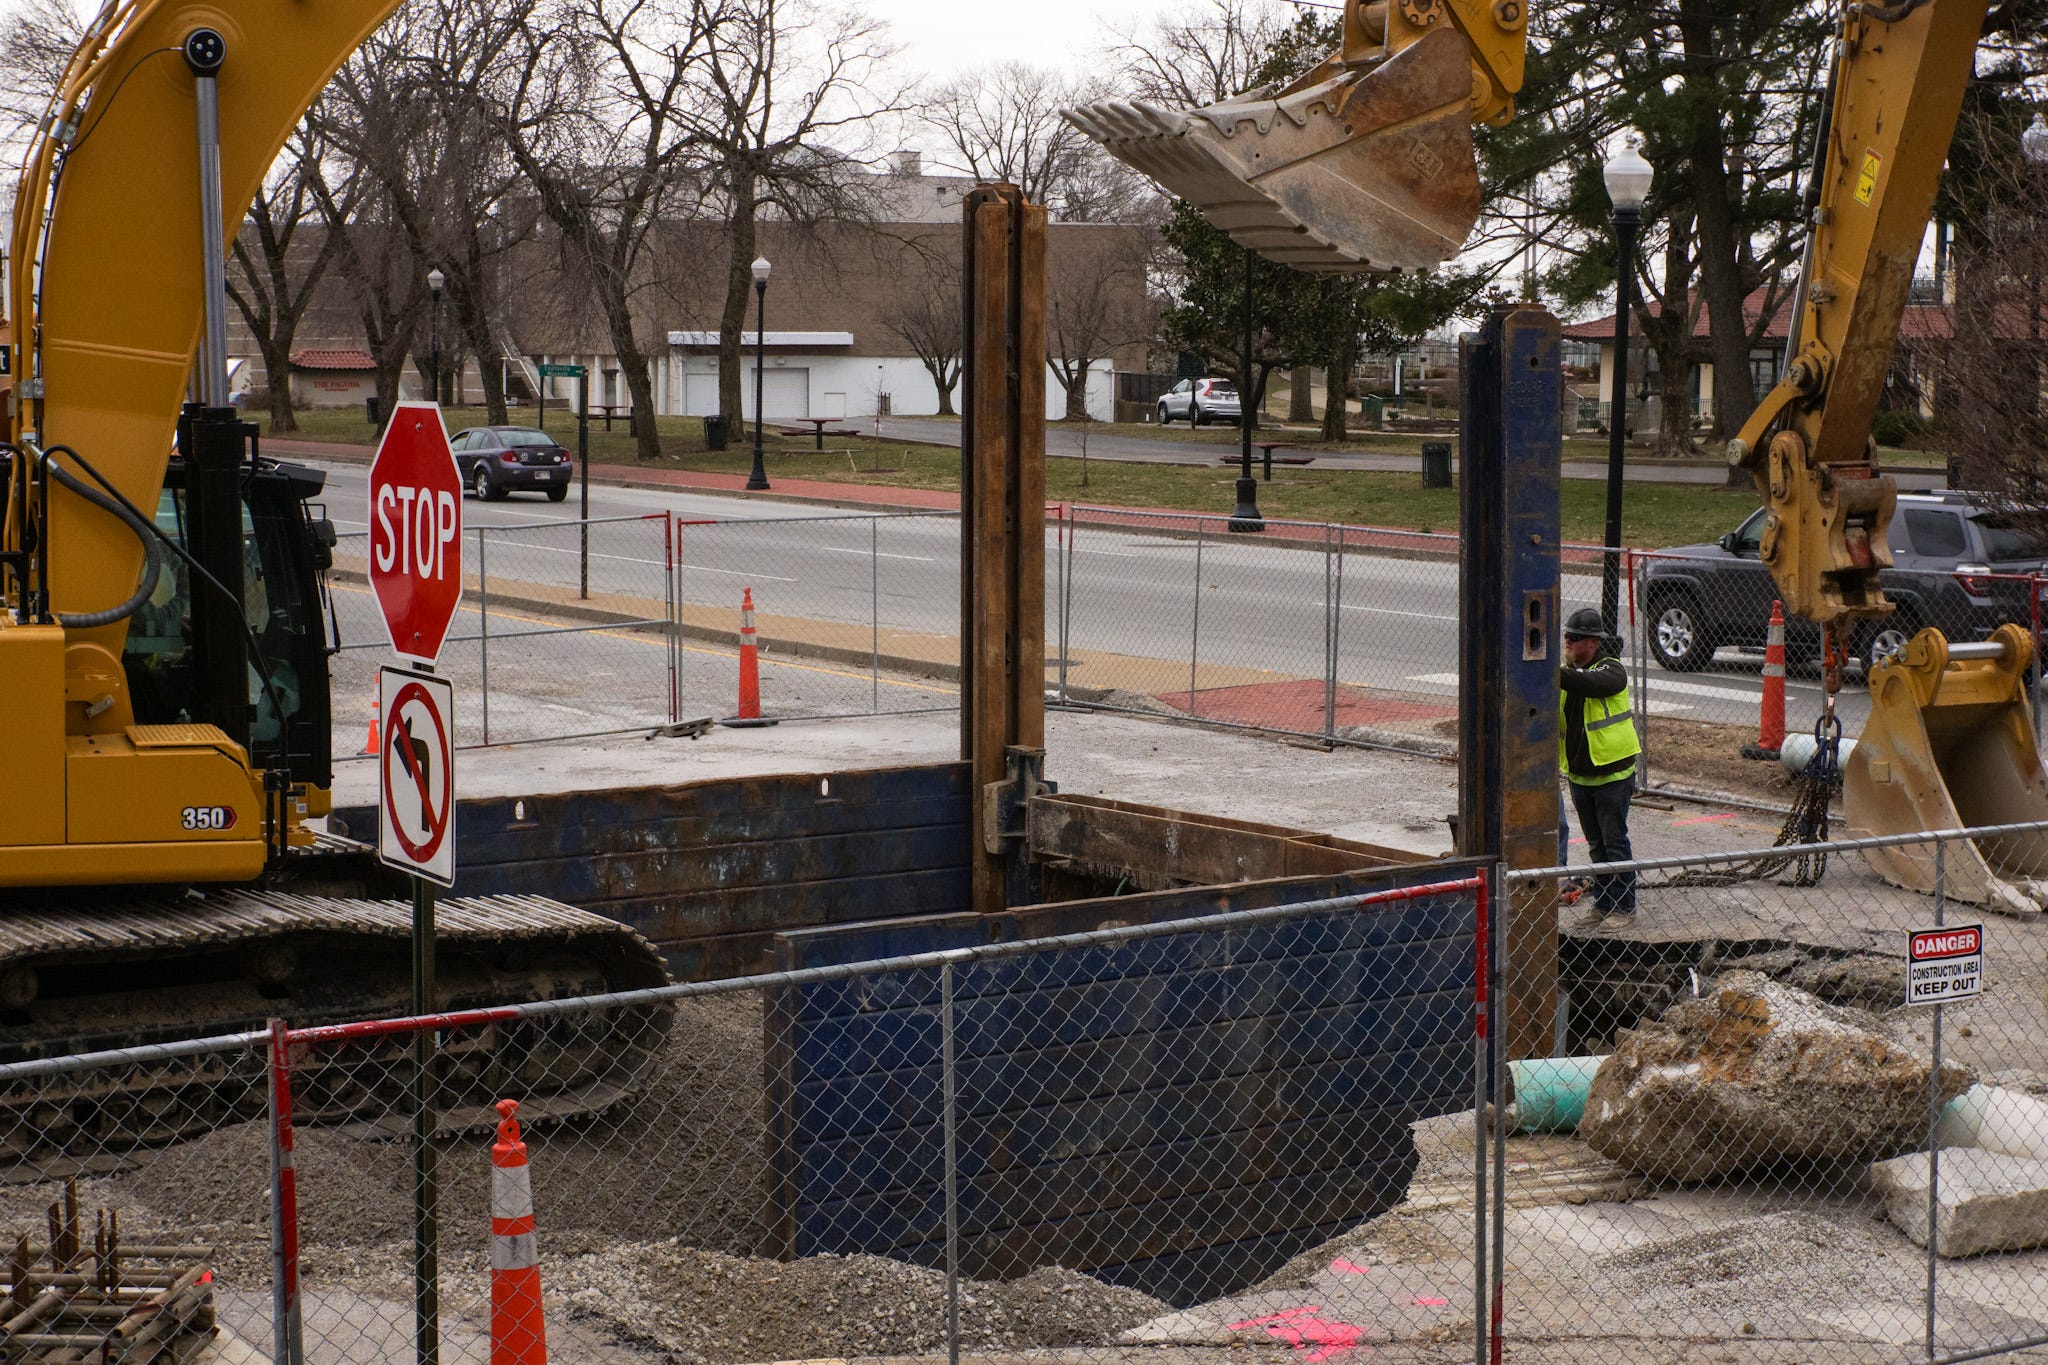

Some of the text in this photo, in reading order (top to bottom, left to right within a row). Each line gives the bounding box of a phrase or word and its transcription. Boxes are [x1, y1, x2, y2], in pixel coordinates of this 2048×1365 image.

[375, 483, 457, 581] STOP
[182, 807, 225, 829] 350
[1915, 934, 1975, 954] DANGER
[1913, 961, 1978, 980] CONSTRUCTION AREA
[1914, 977, 1976, 996] KEEP OUT
